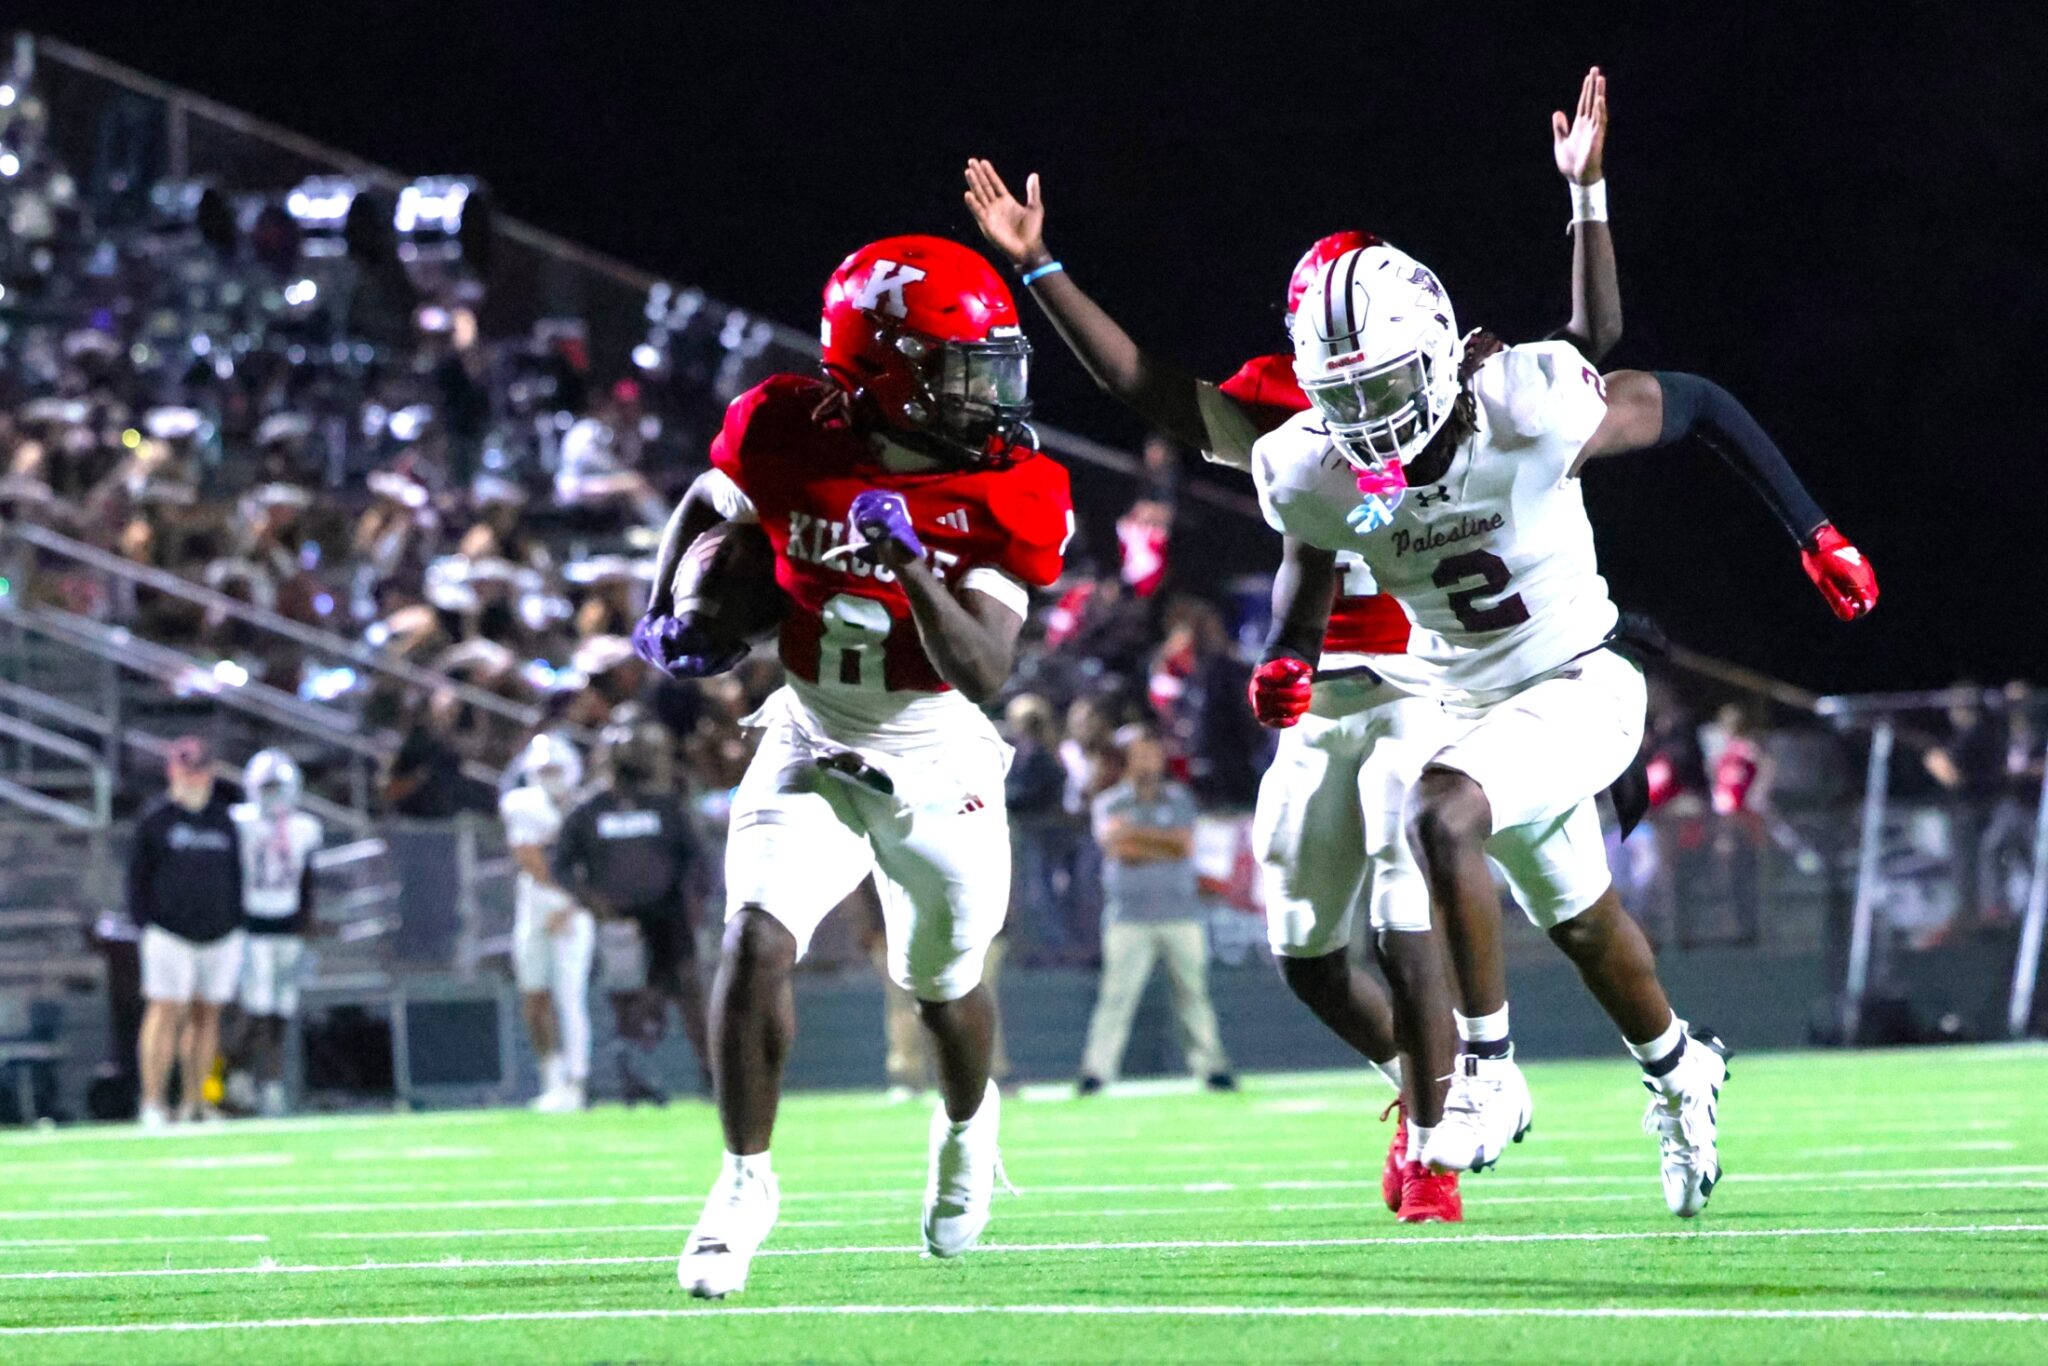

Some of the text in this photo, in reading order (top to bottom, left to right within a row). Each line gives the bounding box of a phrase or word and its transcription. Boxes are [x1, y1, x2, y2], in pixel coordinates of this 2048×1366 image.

[852, 259, 926, 319] K
[787, 511, 958, 583] KILE
[1391, 511, 1505, 558] Palestine
[1431, 548, 1531, 632] 2
[817, 592, 892, 690] 8
